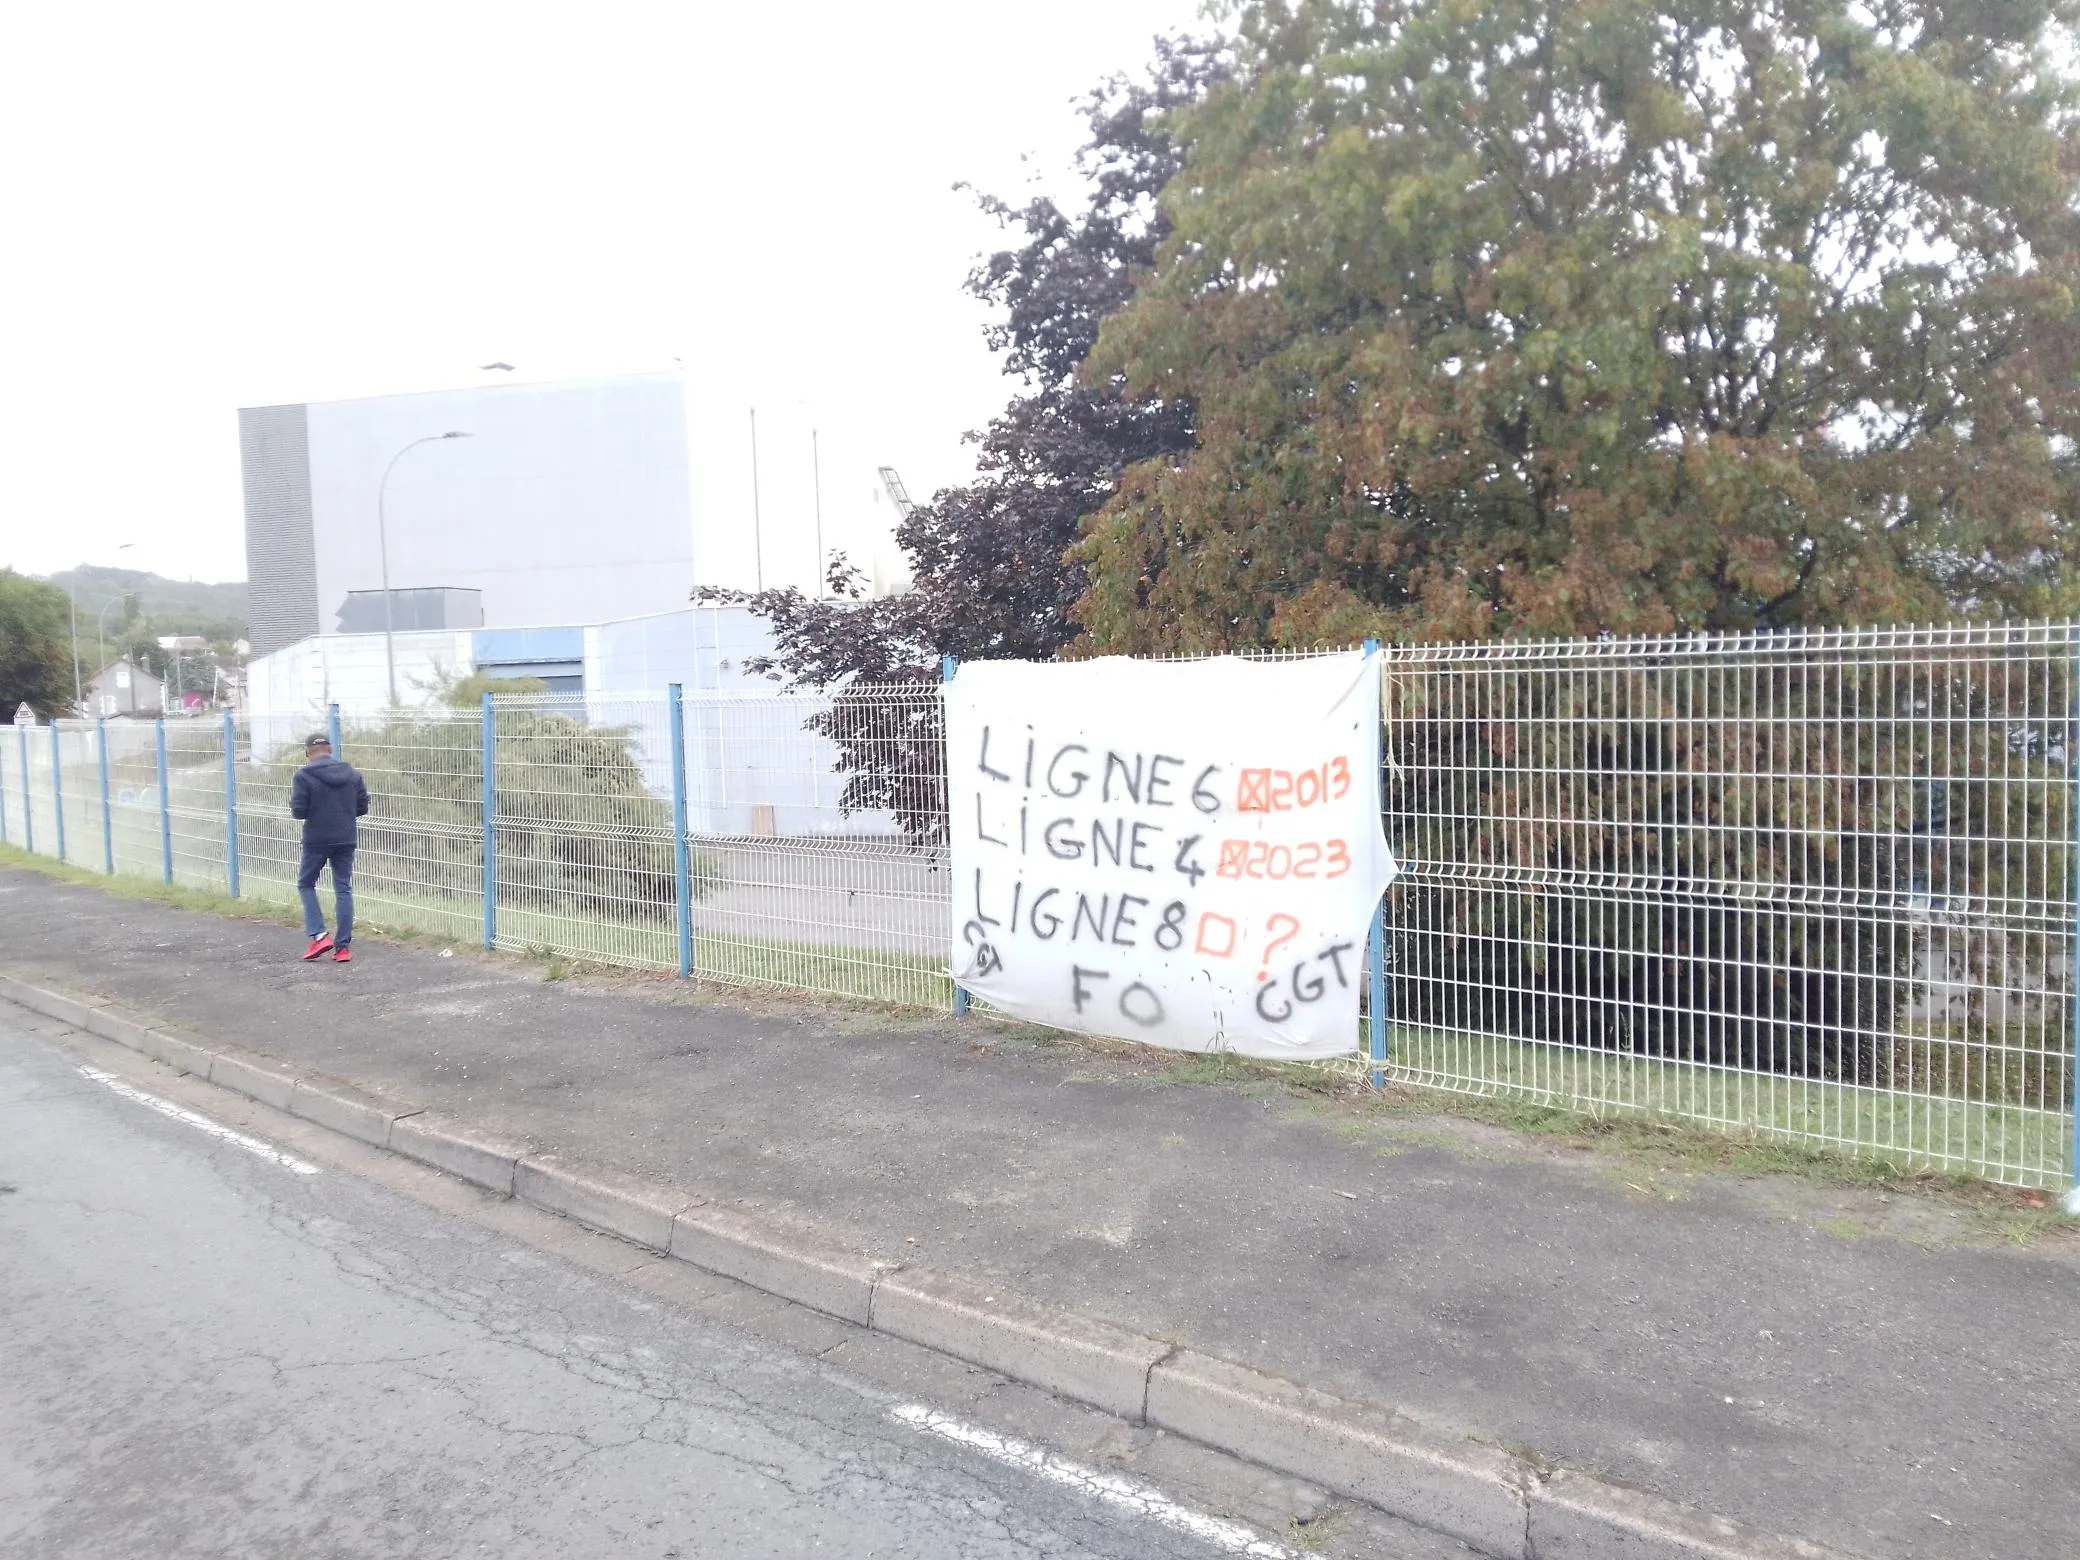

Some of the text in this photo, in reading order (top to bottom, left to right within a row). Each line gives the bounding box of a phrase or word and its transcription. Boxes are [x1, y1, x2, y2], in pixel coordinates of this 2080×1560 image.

[1270, 757, 1351, 808] 2013
[1246, 839, 1351, 880] 2023
[1257, 913, 1300, 982] ?
[1072, 965, 1165, 1026] FO
[1255, 943, 1355, 1023] CGT
